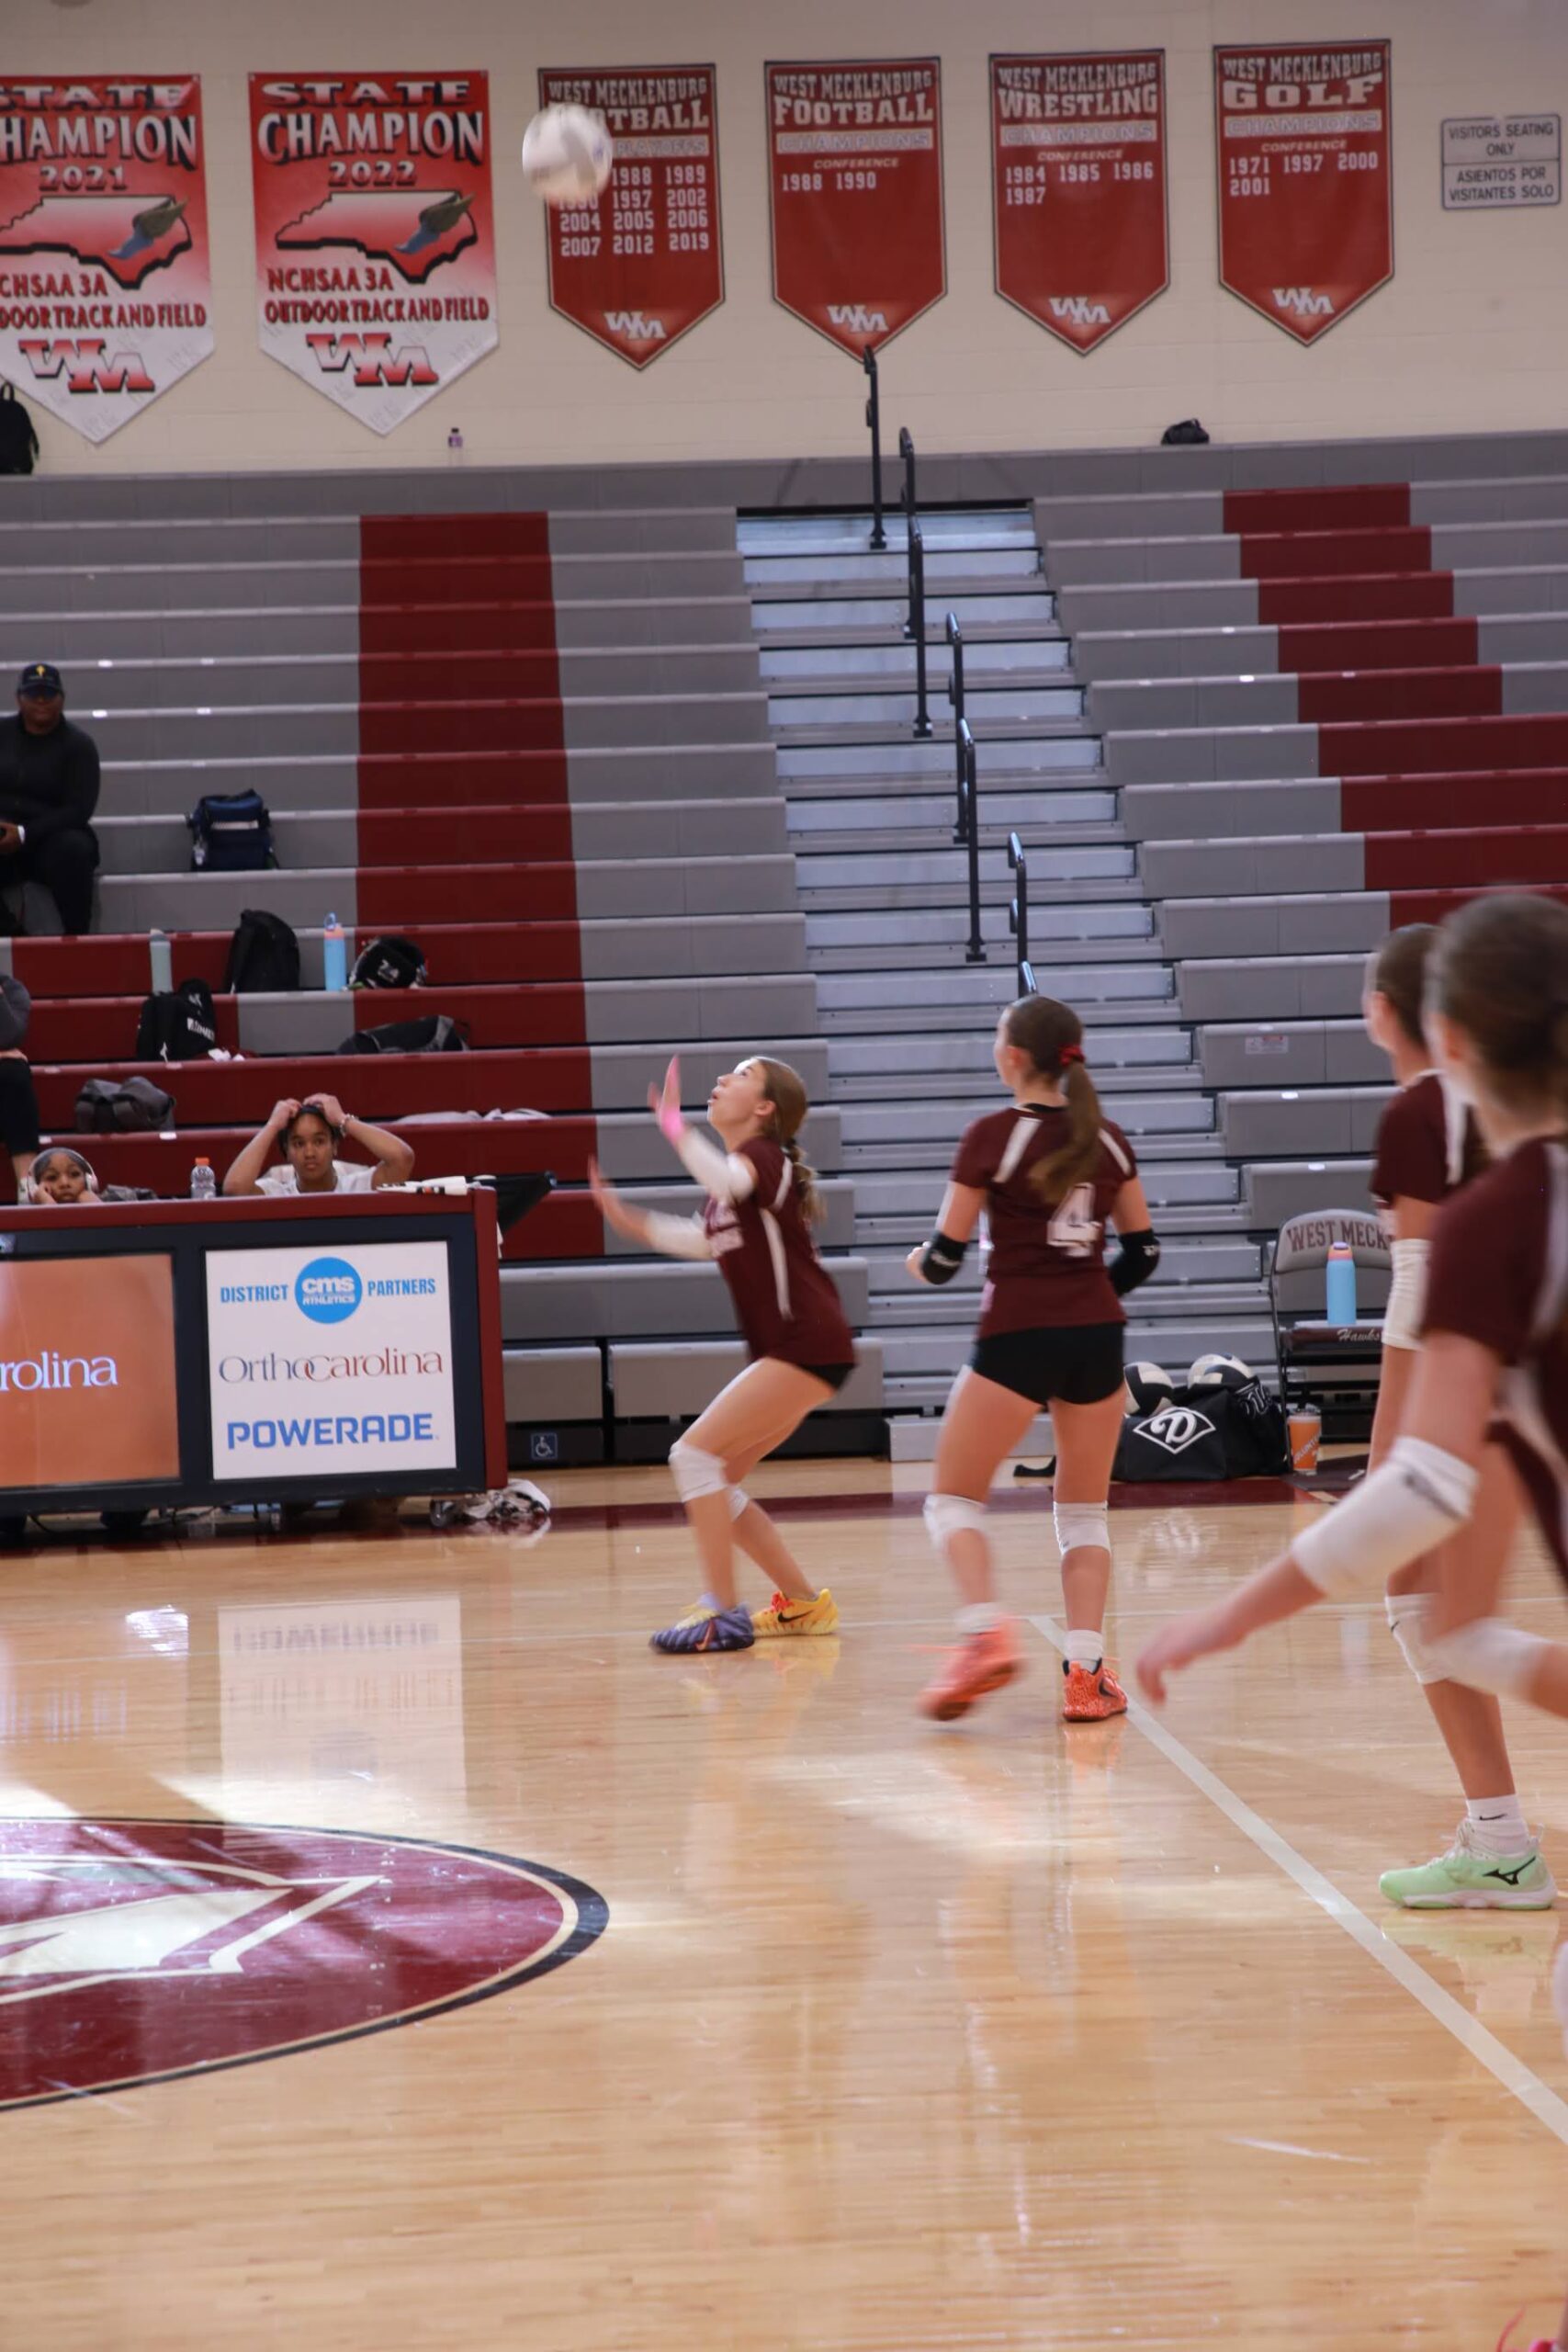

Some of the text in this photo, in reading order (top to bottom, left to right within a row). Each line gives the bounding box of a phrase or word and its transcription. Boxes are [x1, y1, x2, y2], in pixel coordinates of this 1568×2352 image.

[998, 62, 1156, 91] WEST MECKLENBURG
[1223, 52, 1381, 82] WEST MECKLENBURG
[261, 80, 473, 107] STATE
[548, 77, 707, 106] WEST MECKLENBURG
[774, 70, 931, 99] WEST MECKLENBURG
[1223, 73, 1382, 109] GOLF
[774, 92, 933, 126] FOOTBALL
[998, 83, 1157, 119] WRESTLING
[258, 110, 483, 164] CHAMPION
[1005, 125, 1153, 144] CHAMPIONS
[1228, 115, 1377, 134] CHAMPIONS
[1449, 122, 1553, 140] VISITORS SEATING
[783, 132, 929, 151] CHAMPIONS
[1261, 140, 1347, 153] CONFERENCE
[1486, 142, 1514, 156] ONLY
[814, 158, 899, 169] CONFERENCE
[1037, 149, 1123, 161] CONFERENCE
[1229, 152, 1378, 175] 1971 1997 2000
[39, 164, 128, 191] 2021
[328, 160, 417, 187] 2022
[613, 164, 706, 187] 1988 1989
[783, 172, 876, 191] 1988 1990
[1006, 162, 1154, 184] 1984 1985 1986
[1457, 166, 1545, 183] ASIENTOS POR
[613, 189, 652, 209] 1997
[667, 187, 707, 207] 2002
[1006, 187, 1045, 205] 1987
[1230, 177, 1270, 196] 2001
[1450, 184, 1554, 201] VISITANTES SOLO
[559, 209, 708, 232] 2004 2005 2006
[560, 232, 709, 257] 2007 2012 2019
[80, 273, 108, 297] 3A
[267, 266, 393, 293] NCHSAA 3A
[265, 297, 490, 323] OUTDOOR TRACK AND FIELD
[1049, 297, 1111, 324] WM
[1272, 288, 1335, 315] WM
[52, 304, 115, 329] TRACK
[116, 303, 155, 328] AND
[157, 302, 207, 328] FIELD
[603, 311, 666, 339] WM
[827, 304, 889, 333] WM
[17, 338, 155, 393] WM
[305, 333, 440, 387] WM
[1046, 1182, 1102, 1257] 4
[1287, 1220, 1337, 1252] WEST
[220, 1278, 435, 1303] DISTRICT PARTNERS
[301, 1276, 355, 1294] cms
[302, 1294, 355, 1306] ATHLETICS
[1337, 1329, 1380, 1342] Hawks
[0, 1351, 118, 1391] rolina
[219, 1347, 443, 1384] OrthoCarolina
[227, 1413, 434, 1449] POWERADE
